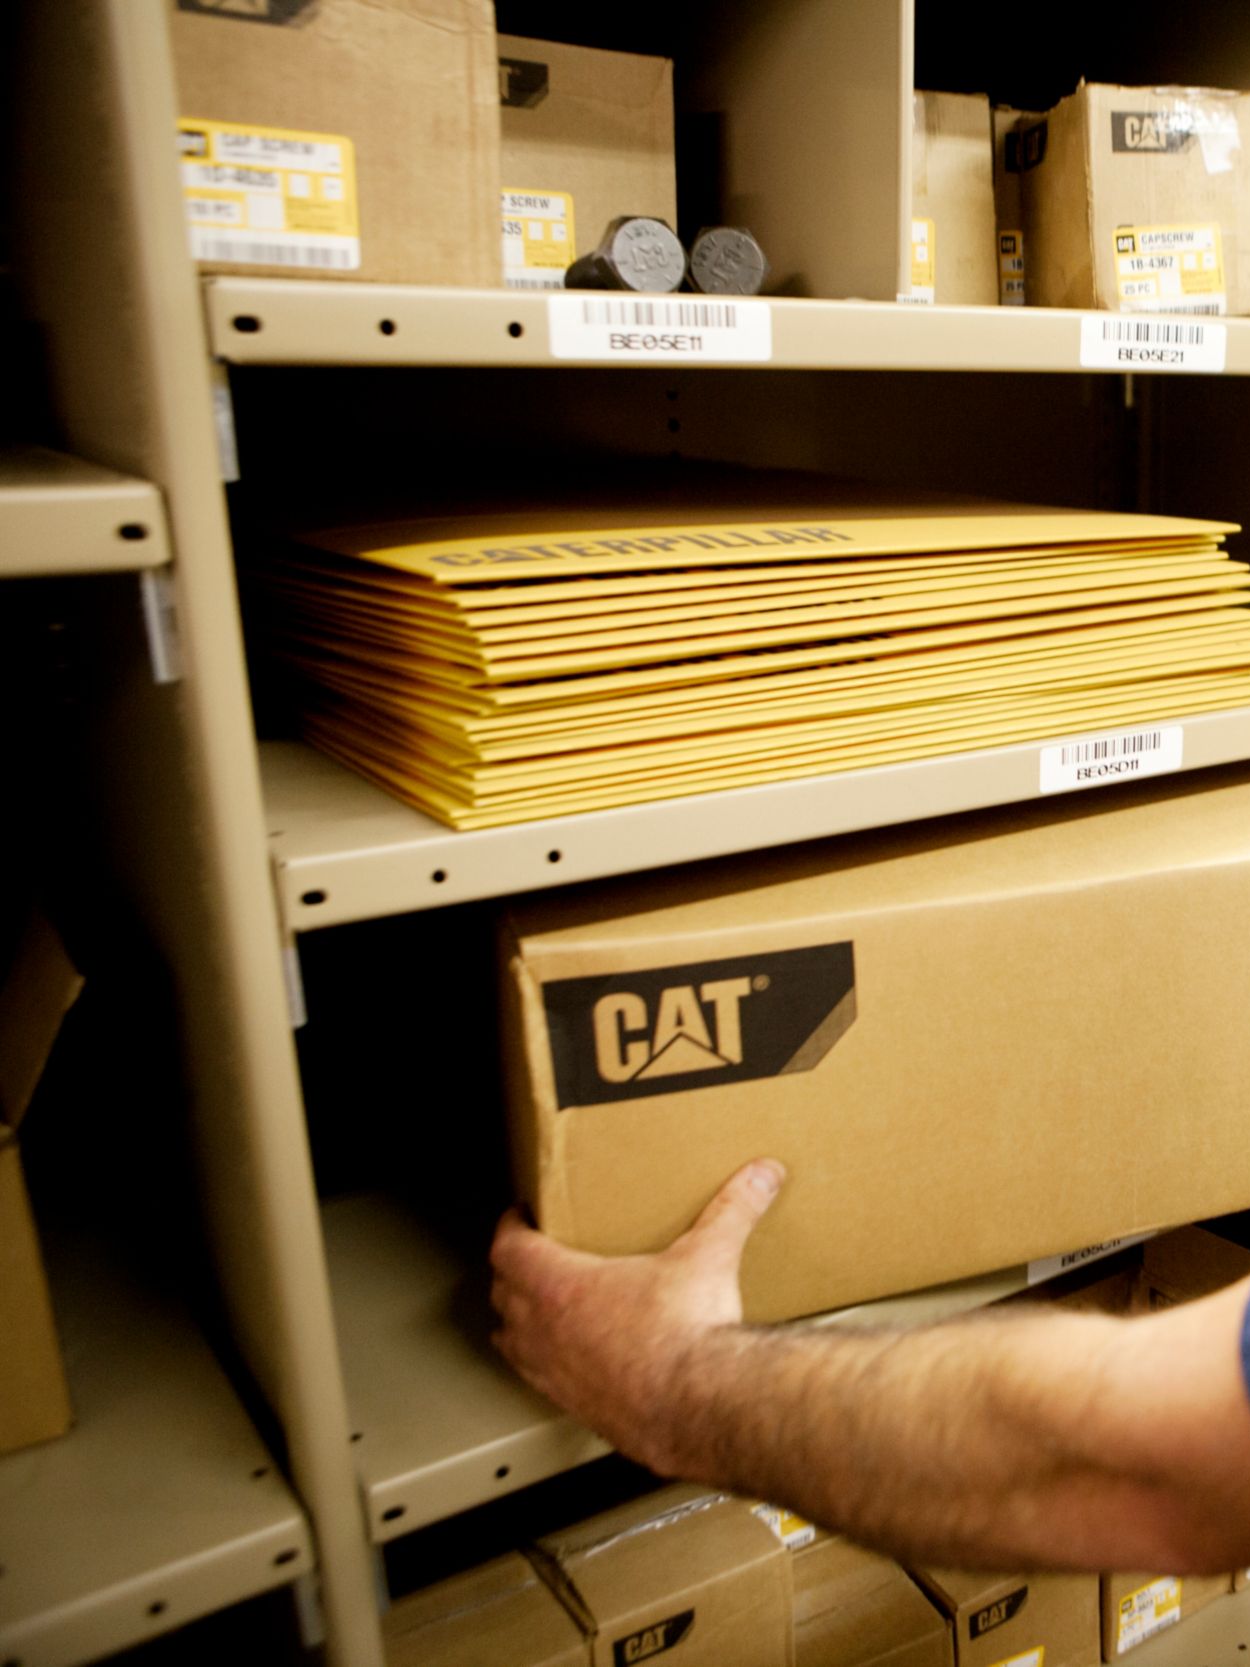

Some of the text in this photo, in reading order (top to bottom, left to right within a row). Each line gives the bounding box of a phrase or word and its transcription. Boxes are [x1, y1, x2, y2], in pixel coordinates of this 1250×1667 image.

[1125, 116, 1167, 148] CAT
[510, 195, 550, 209] SCREW
[1141, 232, 1194, 244] CAPSCREW
[1130, 256, 1174, 270] 1B-4367
[609, 332, 703, 351] BE05E11
[1117, 346, 1185, 363] BE05E21
[428, 526, 856, 568] CATERPILLAR
[1076, 758, 1140, 781] BE05D11
[593, 976, 752, 1083] CAT
[977, 1600, 1009, 1633] CAT
[624, 1624, 669, 1660] CAT
